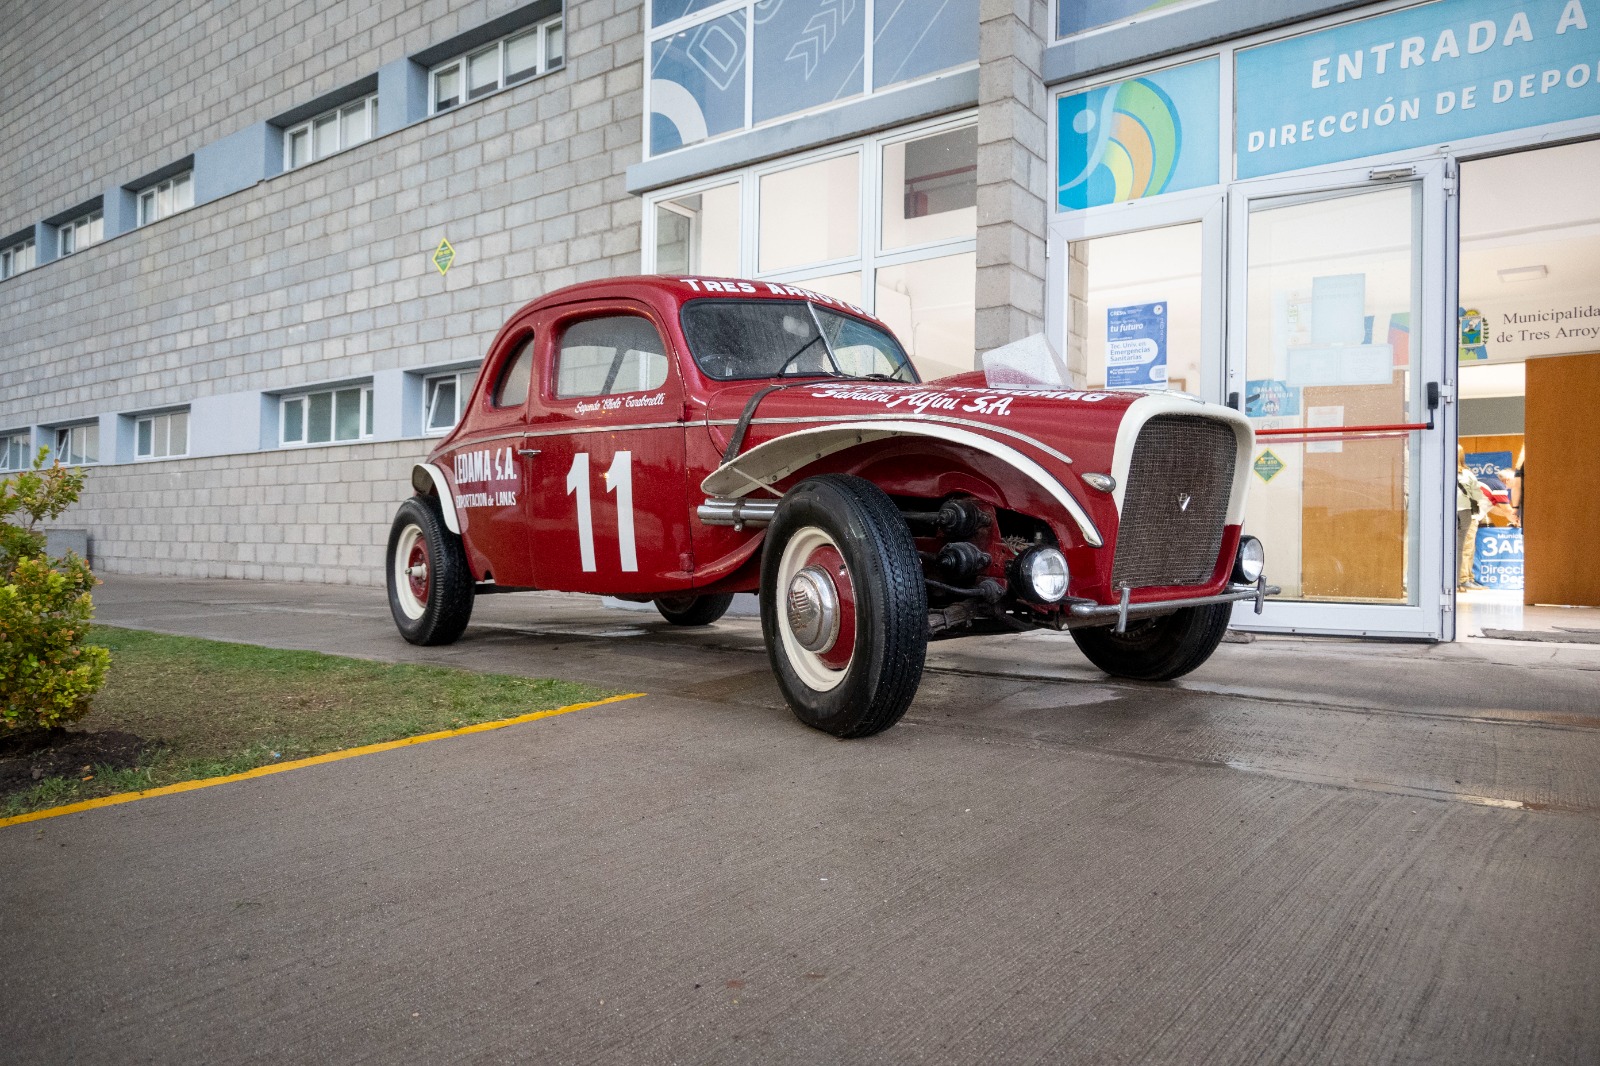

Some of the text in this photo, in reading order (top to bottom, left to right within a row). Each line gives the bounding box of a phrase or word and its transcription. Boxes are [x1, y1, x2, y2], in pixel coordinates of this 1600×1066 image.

[1311, 0, 1588, 89] ENTRADA A
[1247, 59, 1600, 153] DIRECCIÓN DE DEPO
[680, 279, 757, 294] TRES
[1503, 305, 1600, 325] Municipalida
[1110, 323, 1144, 333] tu futuro
[1496, 326, 1600, 343] de Tres Arroy
[1110, 347, 1151, 356] Emergencias
[1110, 354, 1142, 362] Sanitarias
[962, 395, 1014, 416] S.A.
[454, 446, 517, 485] LEDAMA S.A.
[496, 491, 516, 506] LANAS
[566, 450, 639, 573] 11
[1480, 574, 1498, 583] de
